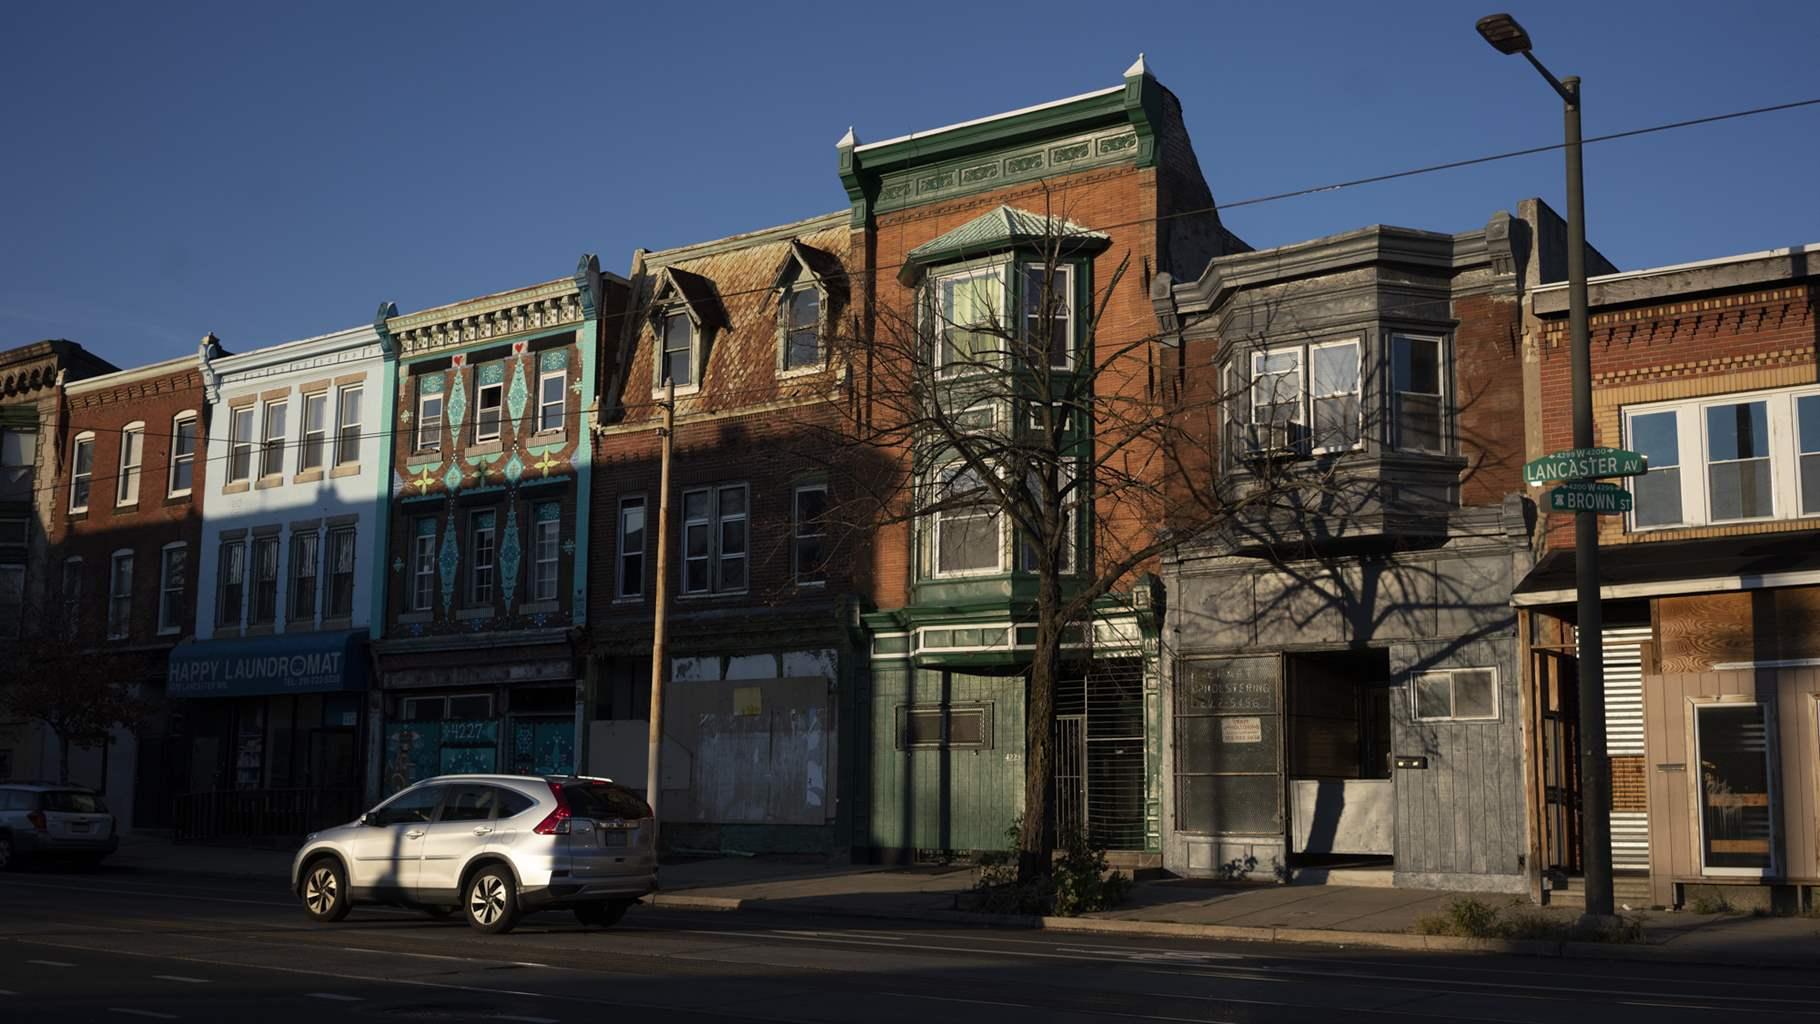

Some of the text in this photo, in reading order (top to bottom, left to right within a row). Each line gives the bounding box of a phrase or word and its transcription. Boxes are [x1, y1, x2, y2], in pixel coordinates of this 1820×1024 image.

[1576, 449, 1585, 458] W
[1586, 448, 1606, 456] 4200
[1527, 457, 1638, 481] LANCASTER AV
[1587, 483, 1596, 491] W
[1568, 493, 1630, 510] BROWN ST
[169, 651, 342, 682] HAPPY LAUNDROMAT
[448, 723, 482, 739] 4227
